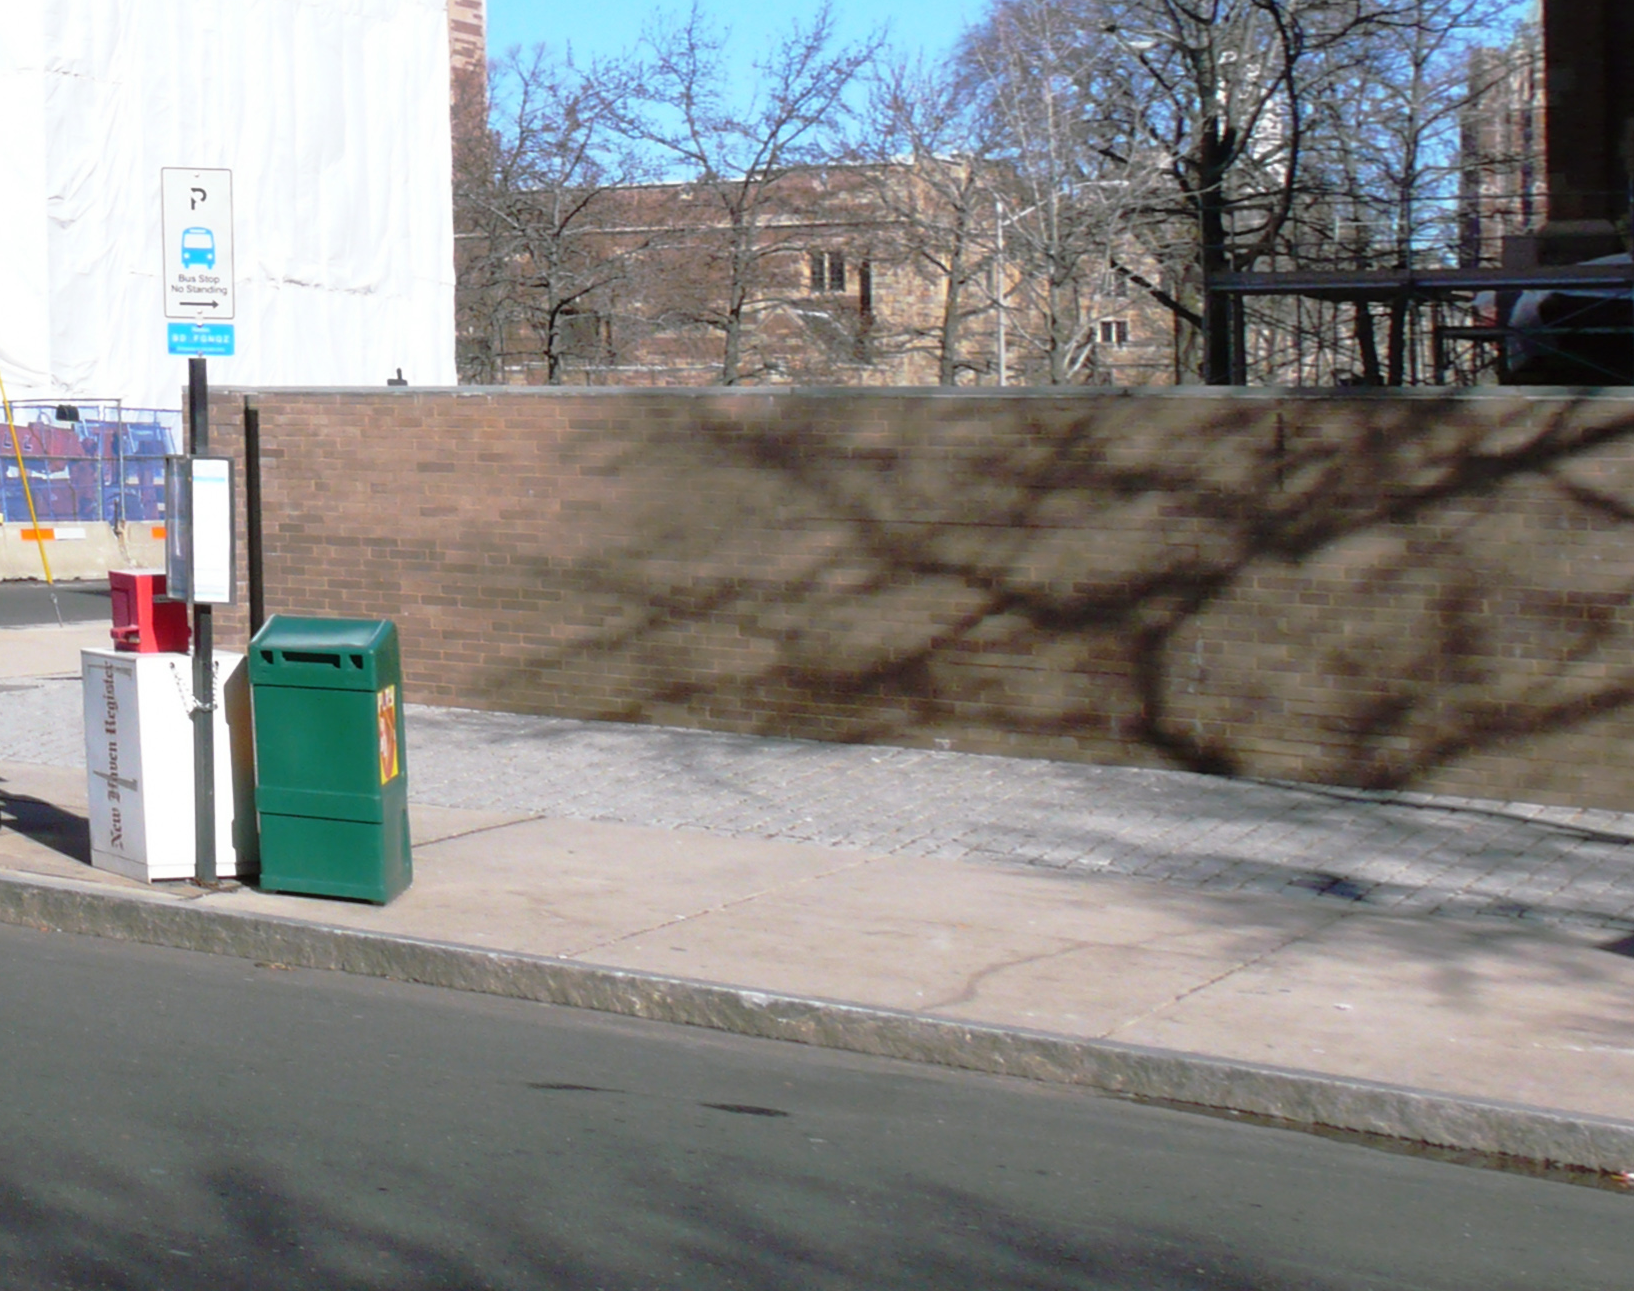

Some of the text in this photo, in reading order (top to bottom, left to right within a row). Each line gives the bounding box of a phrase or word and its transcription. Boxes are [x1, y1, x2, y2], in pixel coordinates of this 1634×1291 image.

[178, 274, 220, 285] Bus Stop
[171, 285, 228, 296] No Standing
[103, 660, 123, 851] New Haven Register
